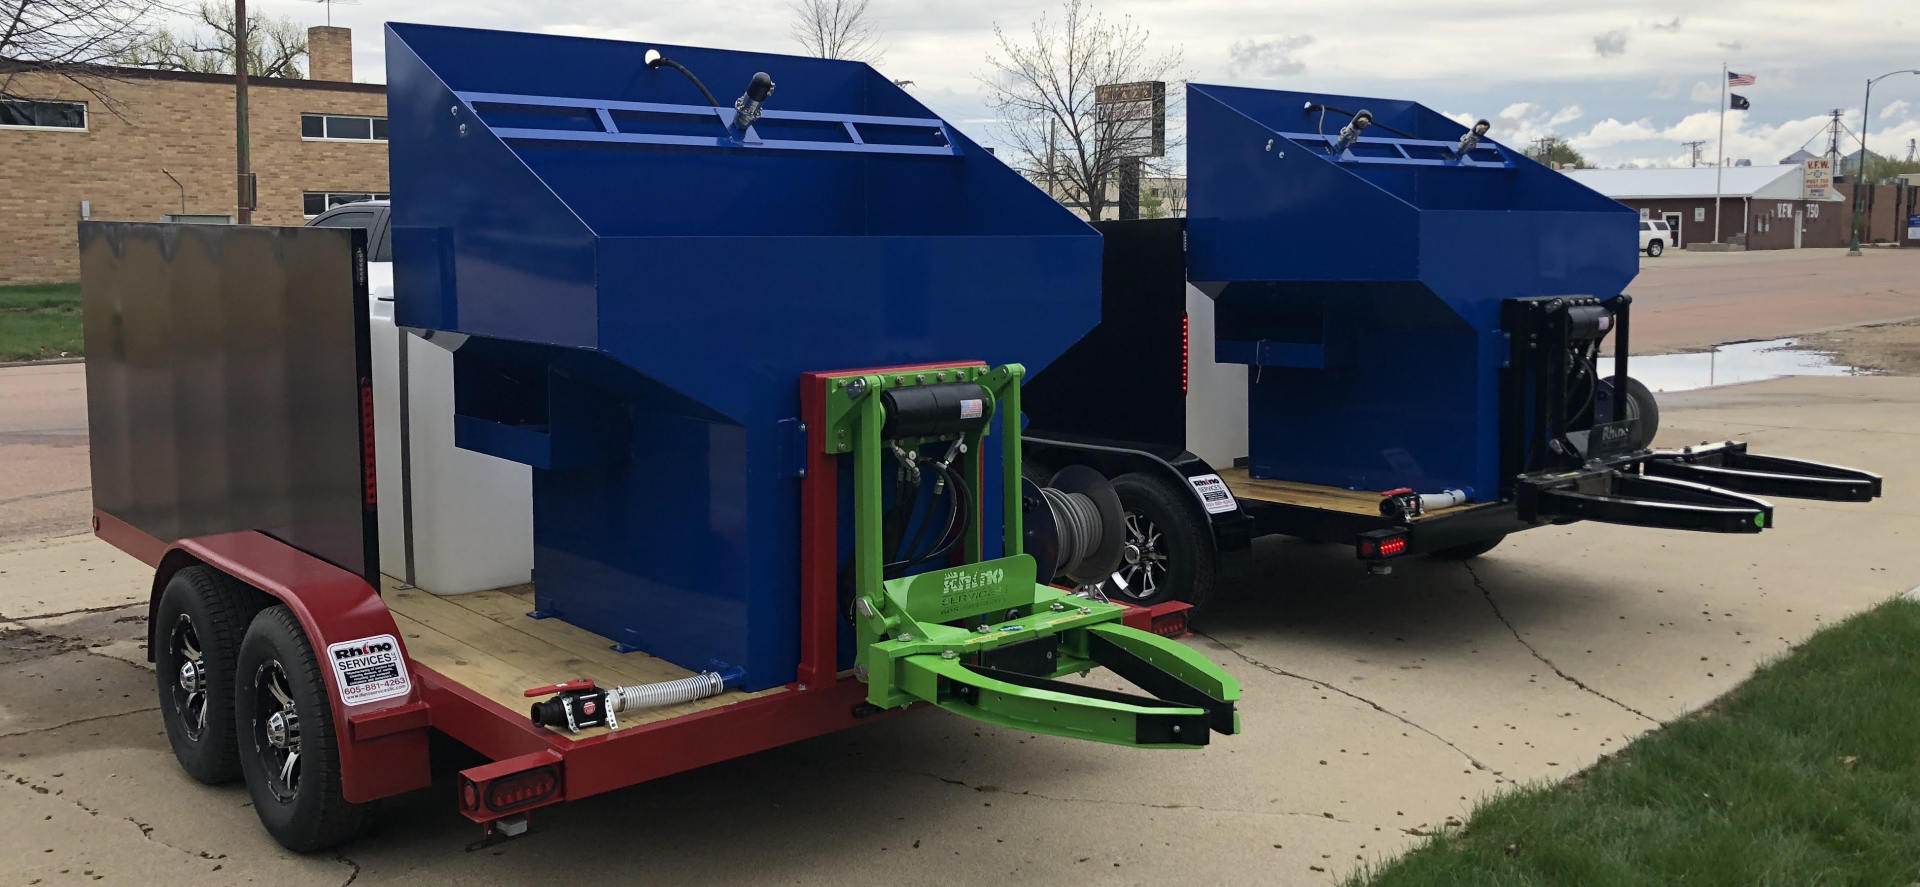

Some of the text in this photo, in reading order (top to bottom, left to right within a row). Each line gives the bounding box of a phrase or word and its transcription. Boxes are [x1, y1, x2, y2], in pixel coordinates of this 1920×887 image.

[1807, 160, 1829, 169] V.F.W.
[1806, 203, 1819, 218] 750
[1193, 478, 1219, 486] Rhino
[335, 642, 392, 660] Rhino
[338, 653, 392, 671] SERVICES
[344, 677, 405, 695] 605-881-4263
